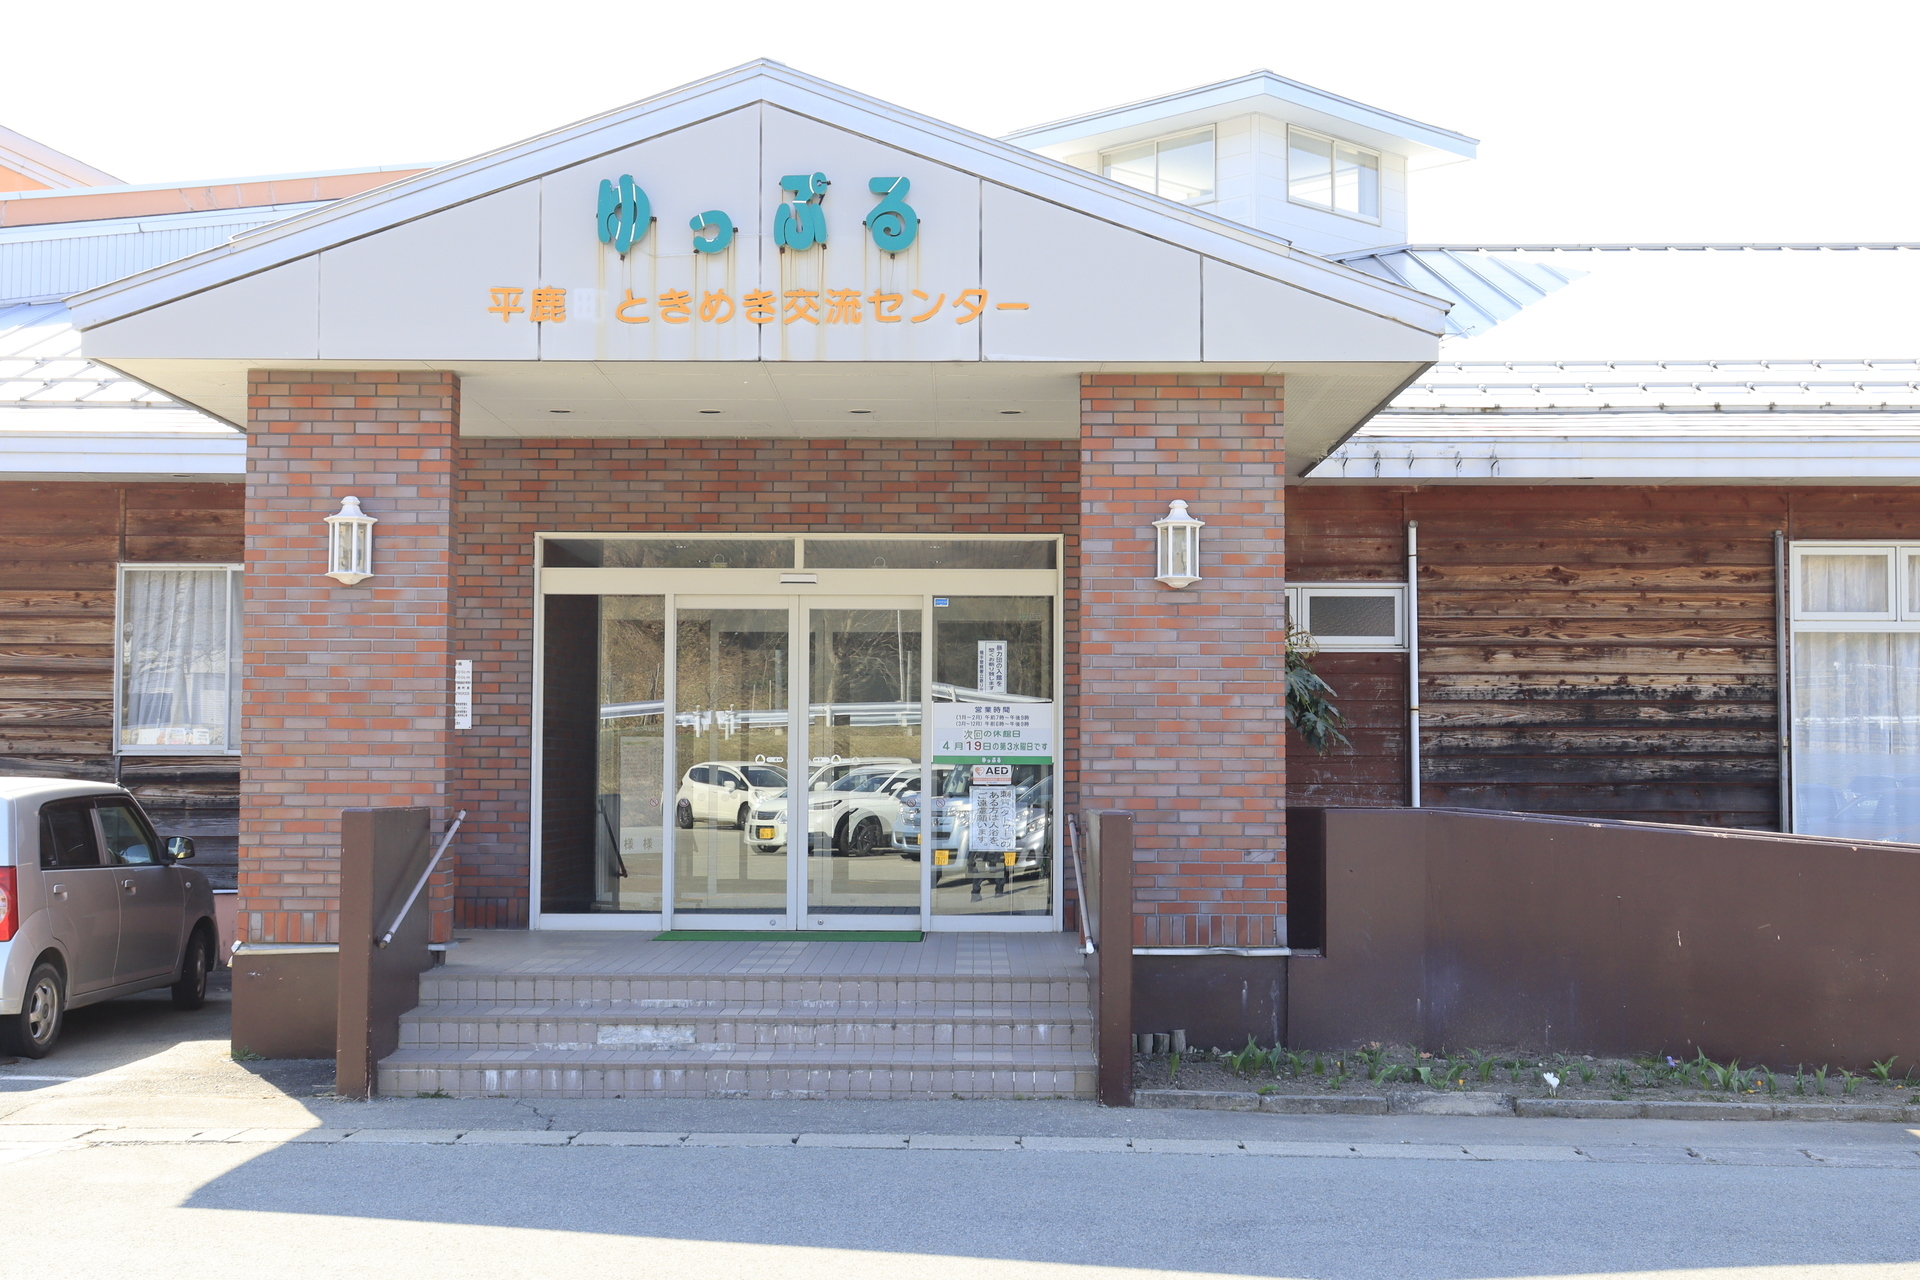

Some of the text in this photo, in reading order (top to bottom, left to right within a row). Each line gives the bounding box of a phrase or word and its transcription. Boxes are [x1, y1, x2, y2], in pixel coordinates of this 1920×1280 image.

[597, 172, 918, 254] ゆっぷる
[975, 706, 1011, 714] 営業時間
[964, 730, 1021, 740] 次回の休館日
[985, 766, 1009, 775] AED
